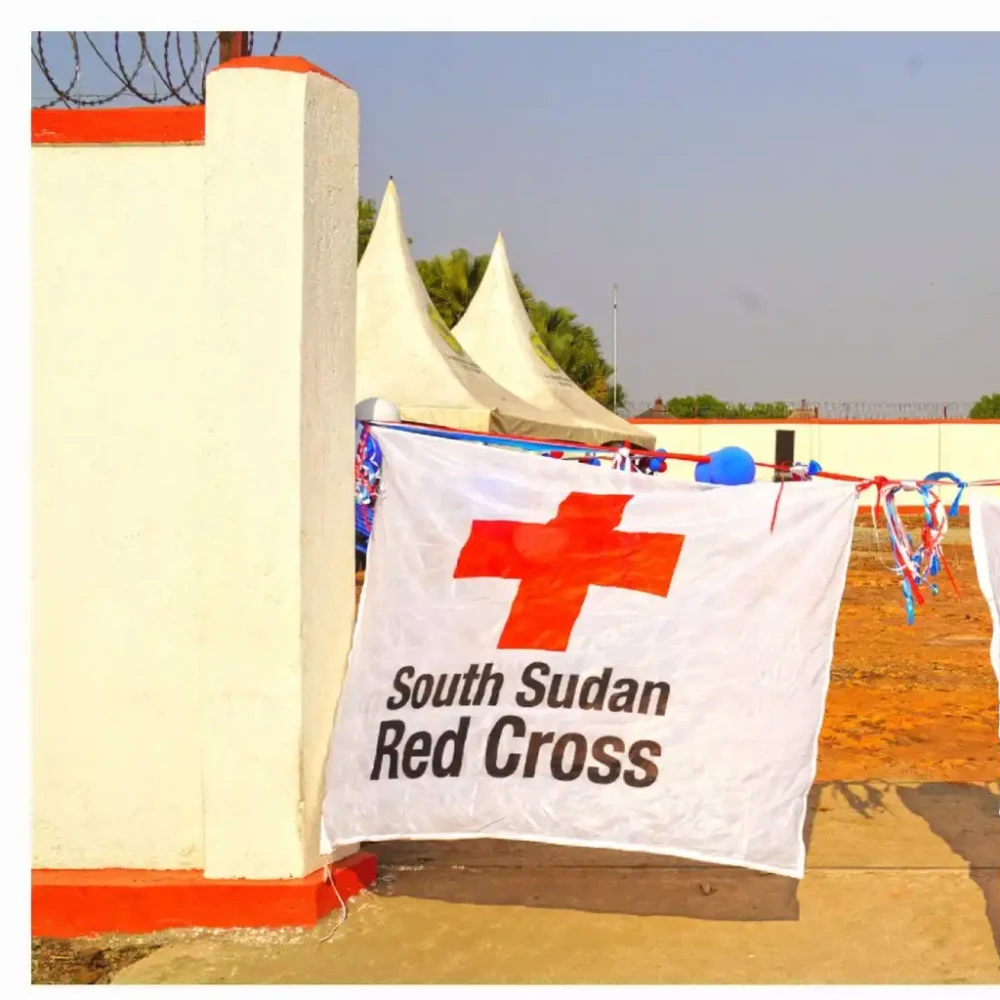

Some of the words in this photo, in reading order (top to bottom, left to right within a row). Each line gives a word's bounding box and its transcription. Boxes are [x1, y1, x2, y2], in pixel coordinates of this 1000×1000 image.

[386, 662, 504, 711] South
[515, 661, 671, 717] Sudan
[369, 716, 471, 781] Red
[484, 715, 662, 788] Cross
